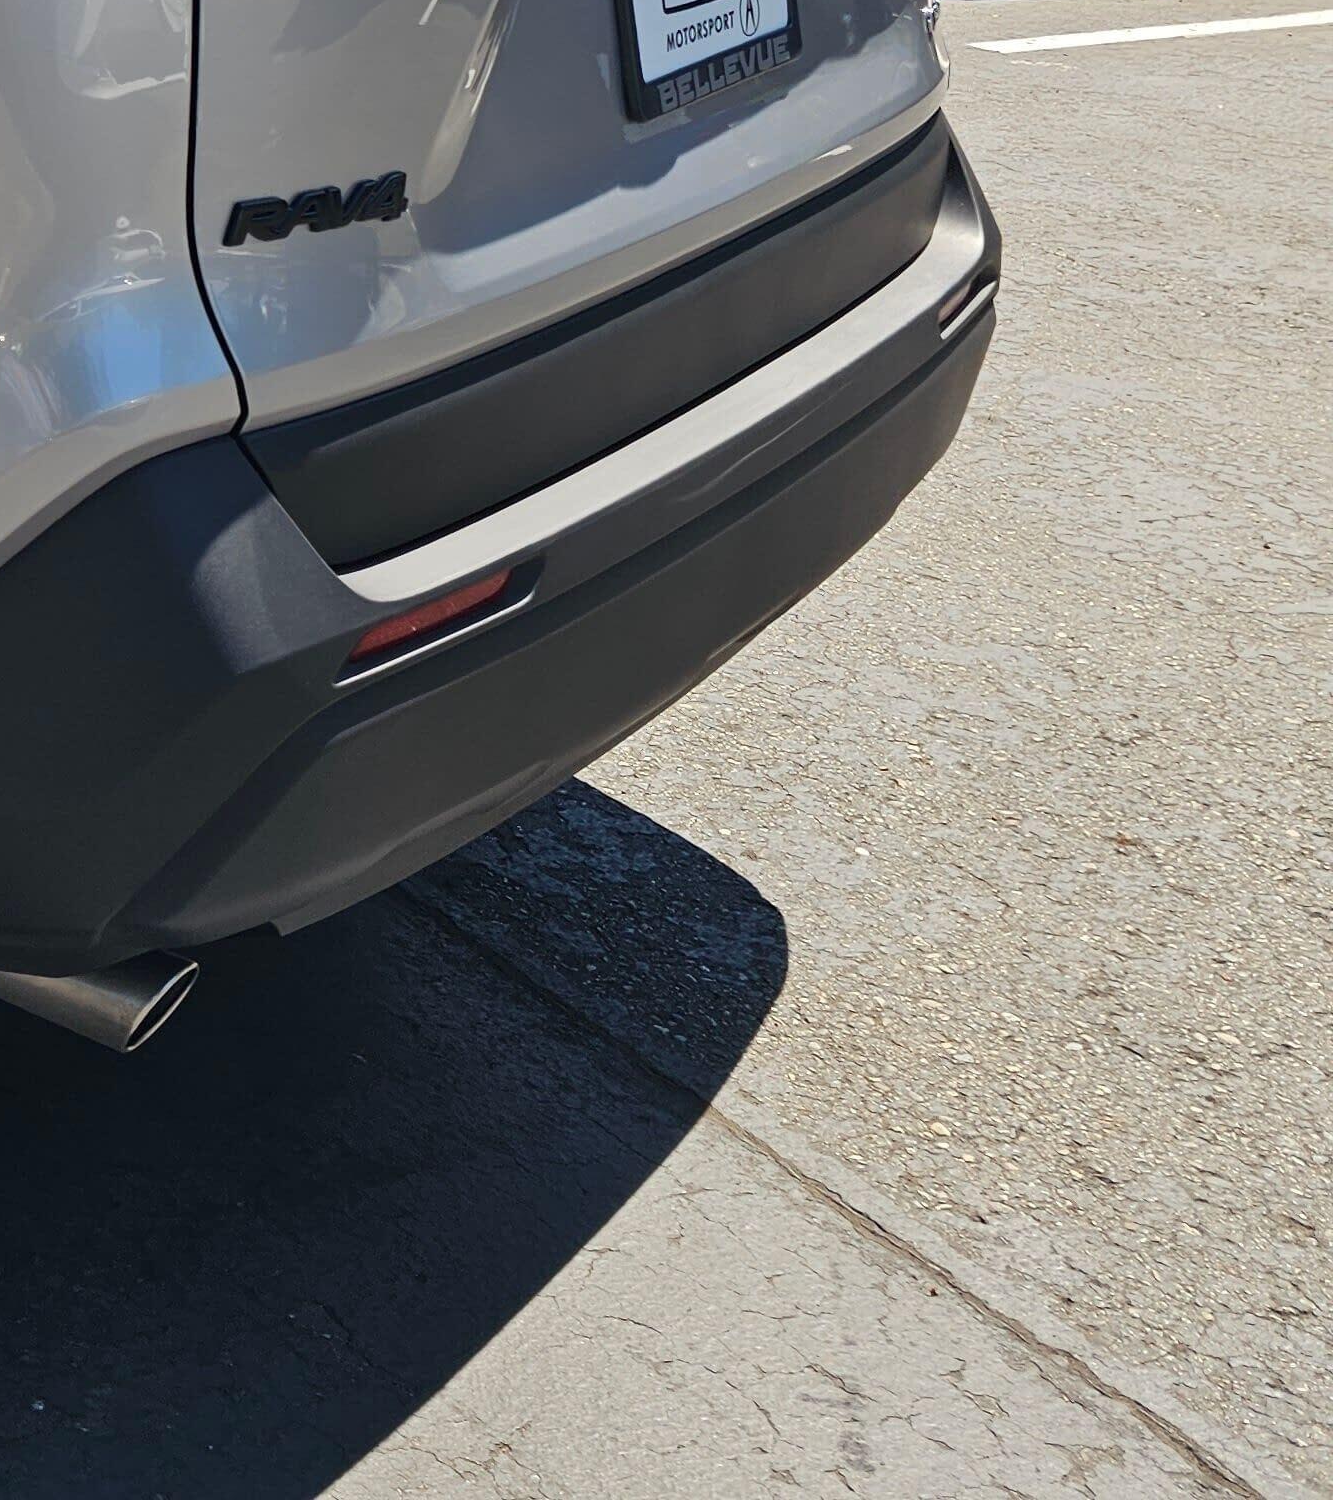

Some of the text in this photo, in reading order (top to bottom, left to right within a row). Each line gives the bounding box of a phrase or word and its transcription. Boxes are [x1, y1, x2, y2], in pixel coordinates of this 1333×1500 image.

[666, 10, 736, 53] MOTORSPORT
[656, 35, 792, 114] BELLEVUE
[222, 170, 409, 247] RAV4
